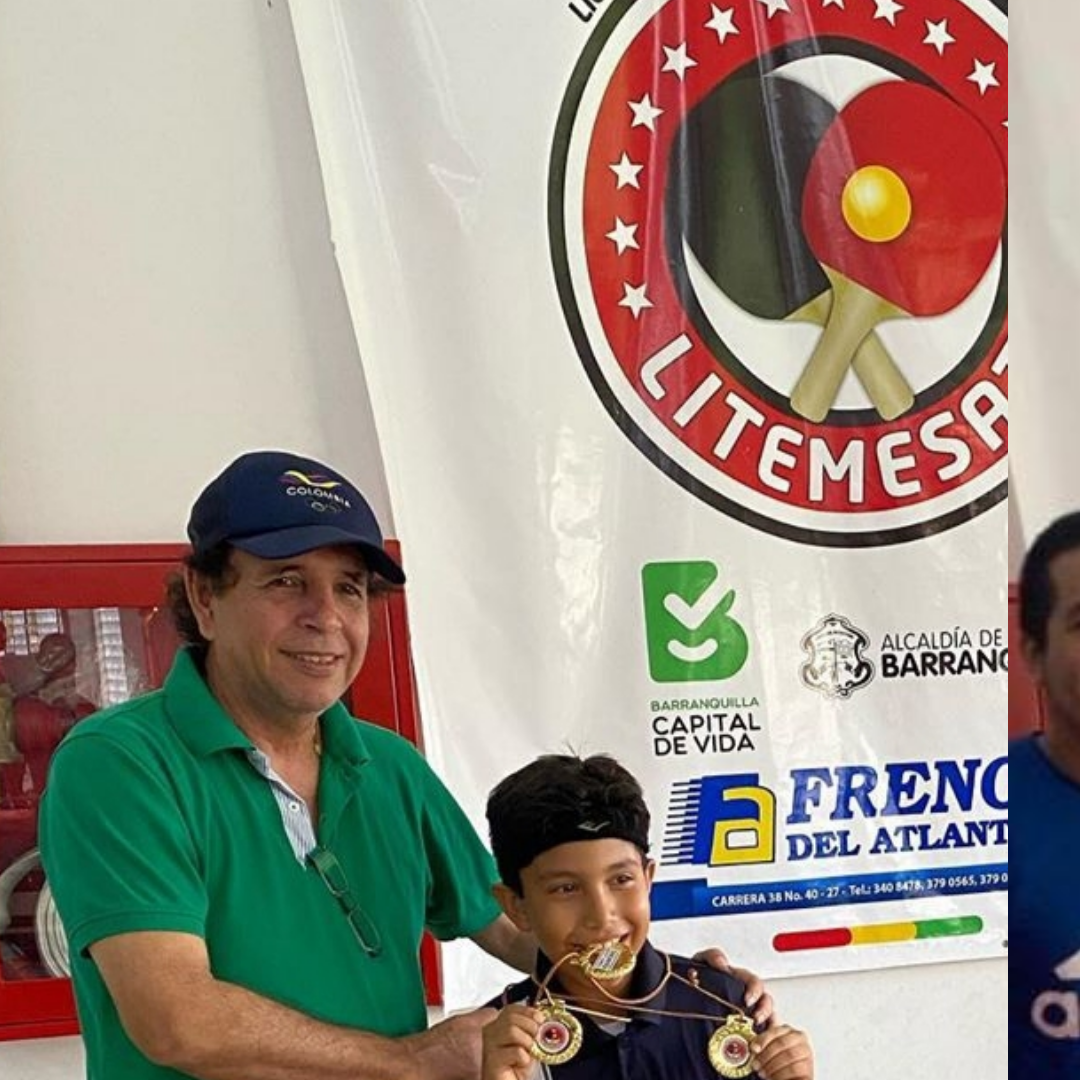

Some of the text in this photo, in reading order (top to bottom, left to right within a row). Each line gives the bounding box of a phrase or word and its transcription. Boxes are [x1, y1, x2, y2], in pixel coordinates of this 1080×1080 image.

[640, 332, 1008, 504] LITEMESA
[881, 626, 1002, 652] ALCALDÍA DE
[650, 697, 760, 712] BARRANQUILLA
[652, 712, 761, 735] CAPITAL
[654, 733, 755, 756] DE VIDA
[786, 830, 861, 861] DEL
[711, 892, 766, 907] CARRERA
[769, 891, 782, 903] 38
[784, 890, 803, 901] No.
[805, 888, 818, 899] 40
[827, 886, 840, 898] 27
[874, 882, 893, 894] 340
[927, 878, 946, 889] 379
[948, 876, 977, 888] 0565,
[980, 874, 999, 885] 379
